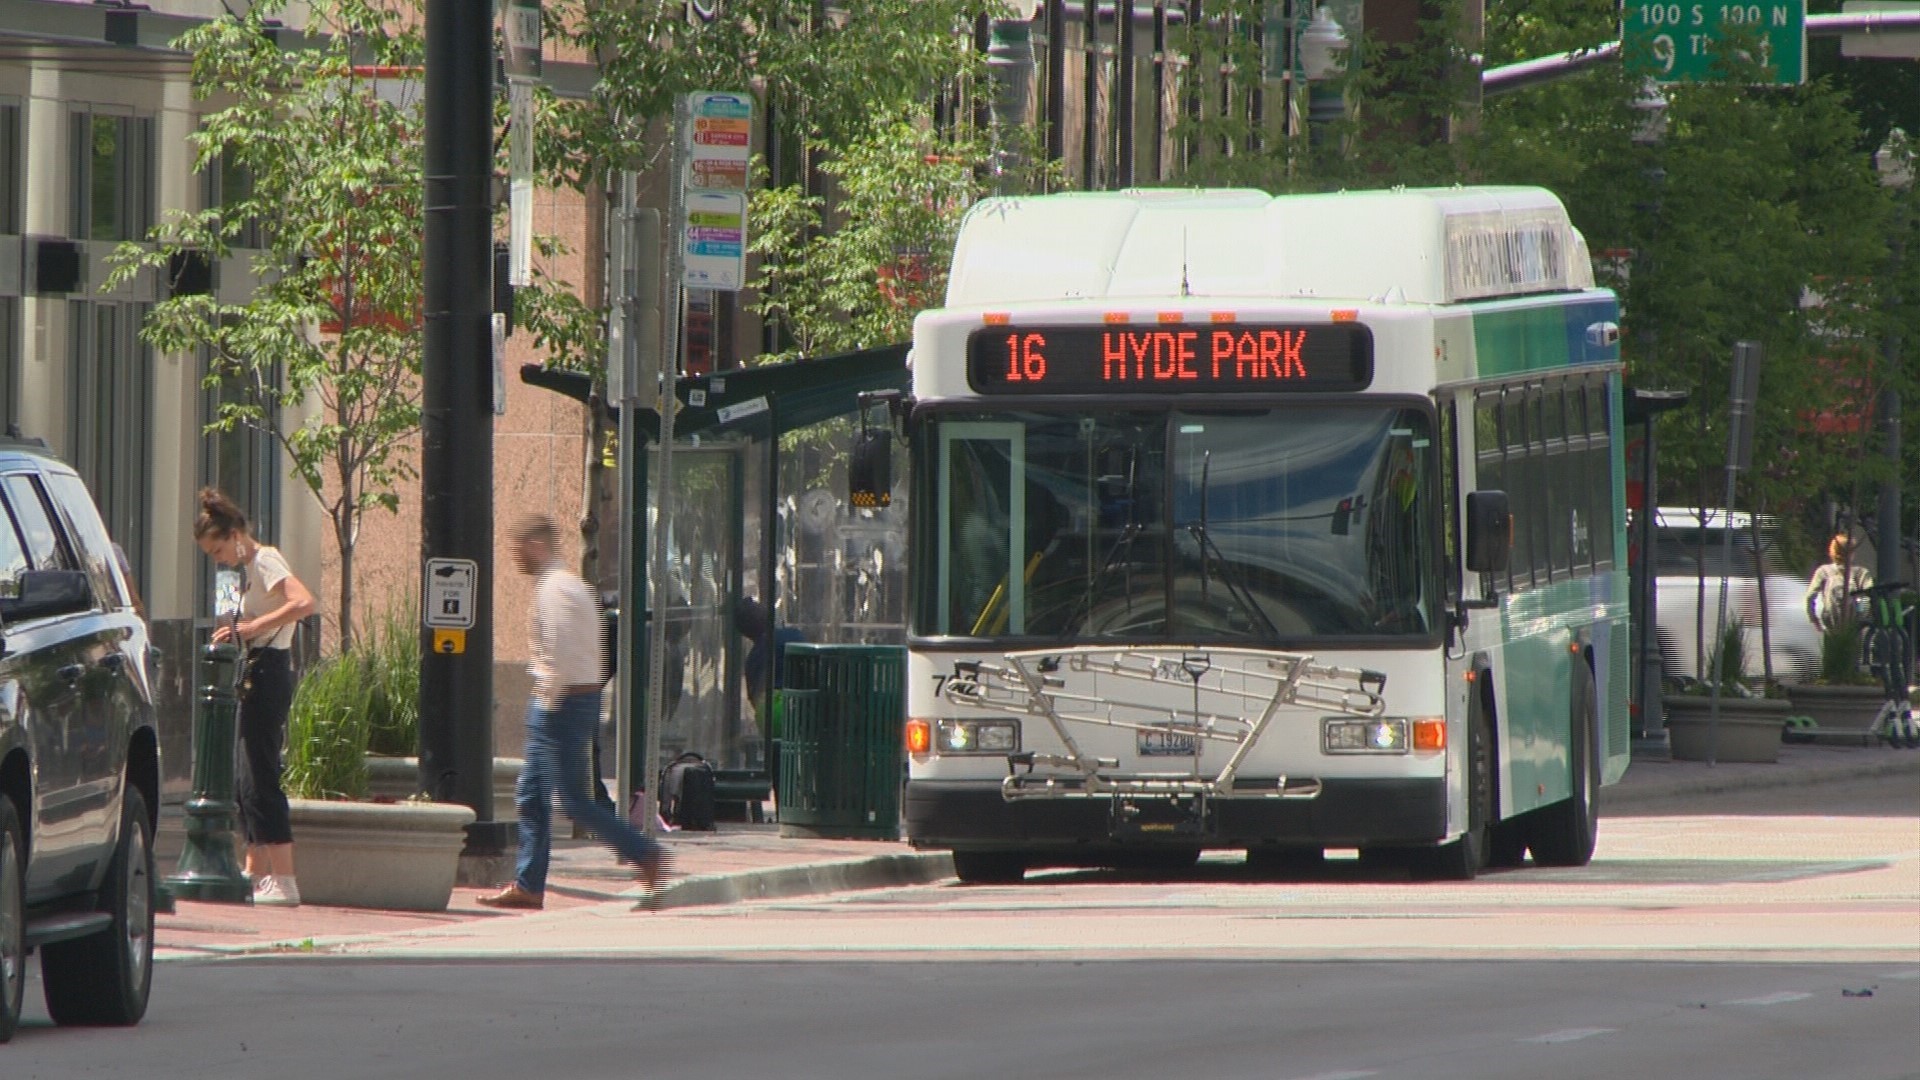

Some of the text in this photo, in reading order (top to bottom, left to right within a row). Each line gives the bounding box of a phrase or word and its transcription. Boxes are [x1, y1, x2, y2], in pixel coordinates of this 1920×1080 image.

[1640, 4, 1788, 26] 100 S 100 N
[1653, 34, 1675, 73] 9
[1005, 330, 1307, 381] 16 HYDE PARK
